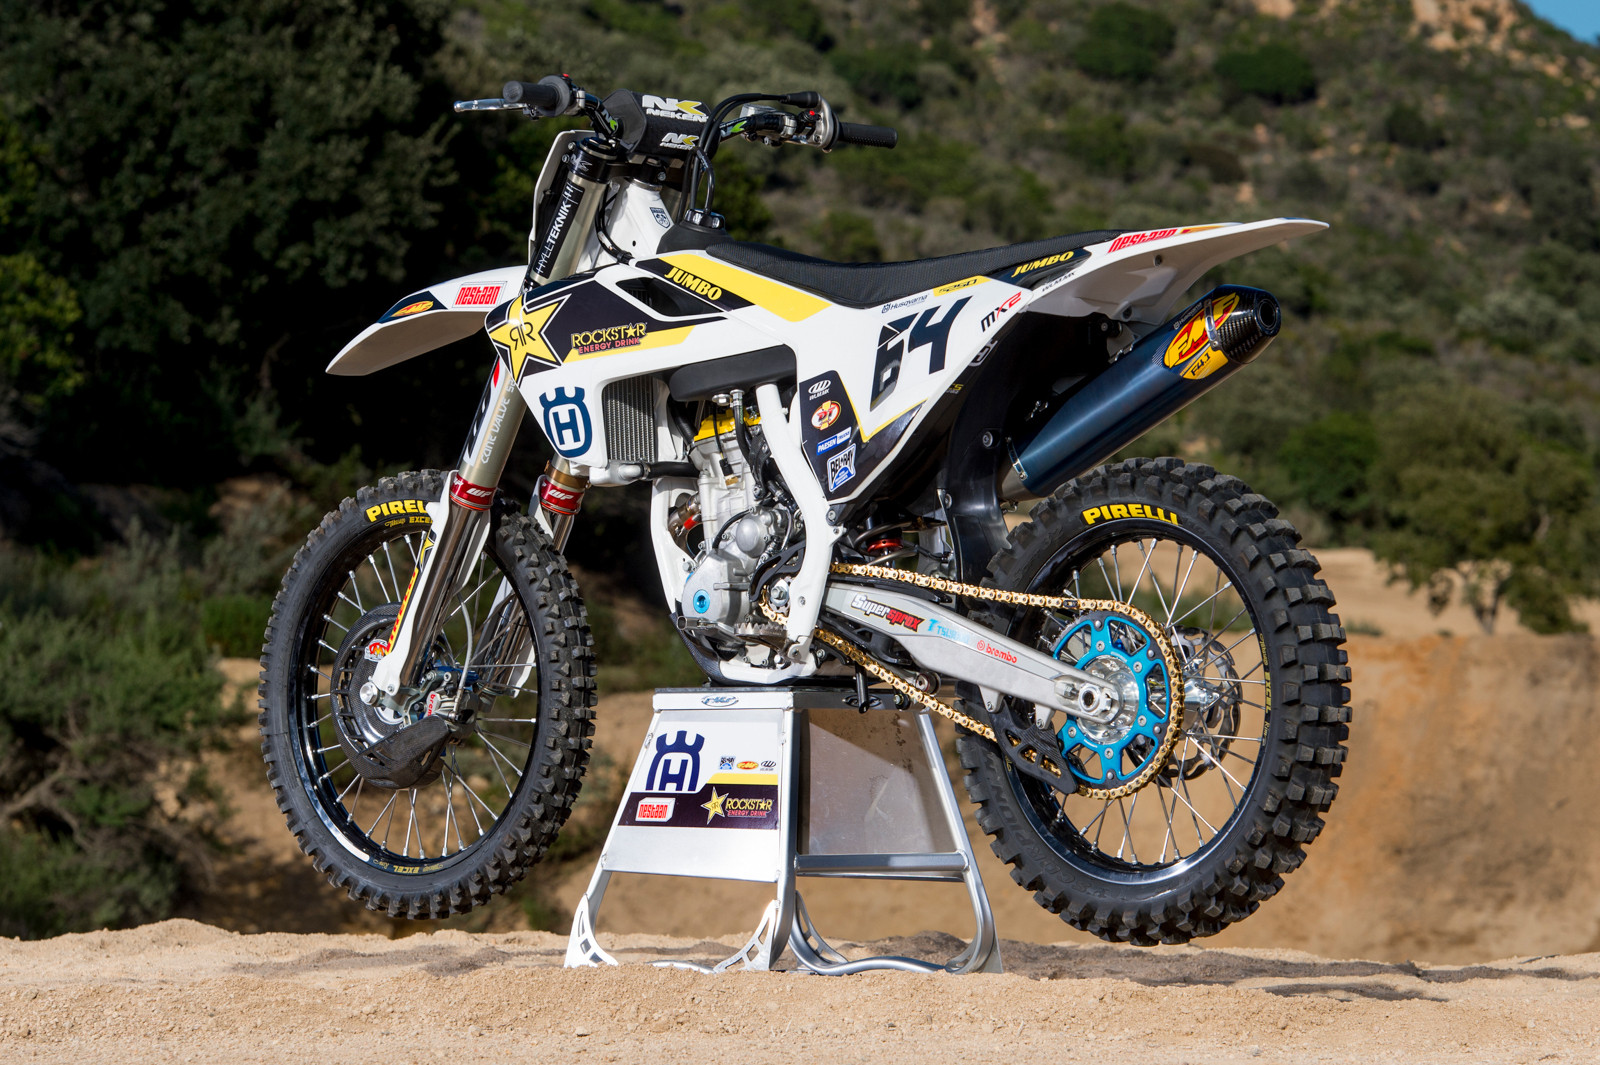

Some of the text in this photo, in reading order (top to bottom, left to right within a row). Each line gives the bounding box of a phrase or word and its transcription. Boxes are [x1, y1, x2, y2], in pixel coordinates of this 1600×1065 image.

[646, 109, 709, 122] NEKEN
[1011, 250, 1075, 278] JUMBO
[664, 266, 723, 301] JUMBO
[1168, 292, 1239, 369] FMF
[578, 336, 641, 354] ENERGY DRINK
[870, 295, 974, 412] 64
[466, 488, 492, 498] WP
[549, 489, 574, 500] WP
[366, 500, 428, 522] PIREL
[409, 516, 432, 524] EXCE
[1082, 503, 1179, 526] PIRELLI
[985, 643, 1018, 664] brembo
[427, 693, 436, 717] brem
[393, 865, 420, 874] EXCEL
